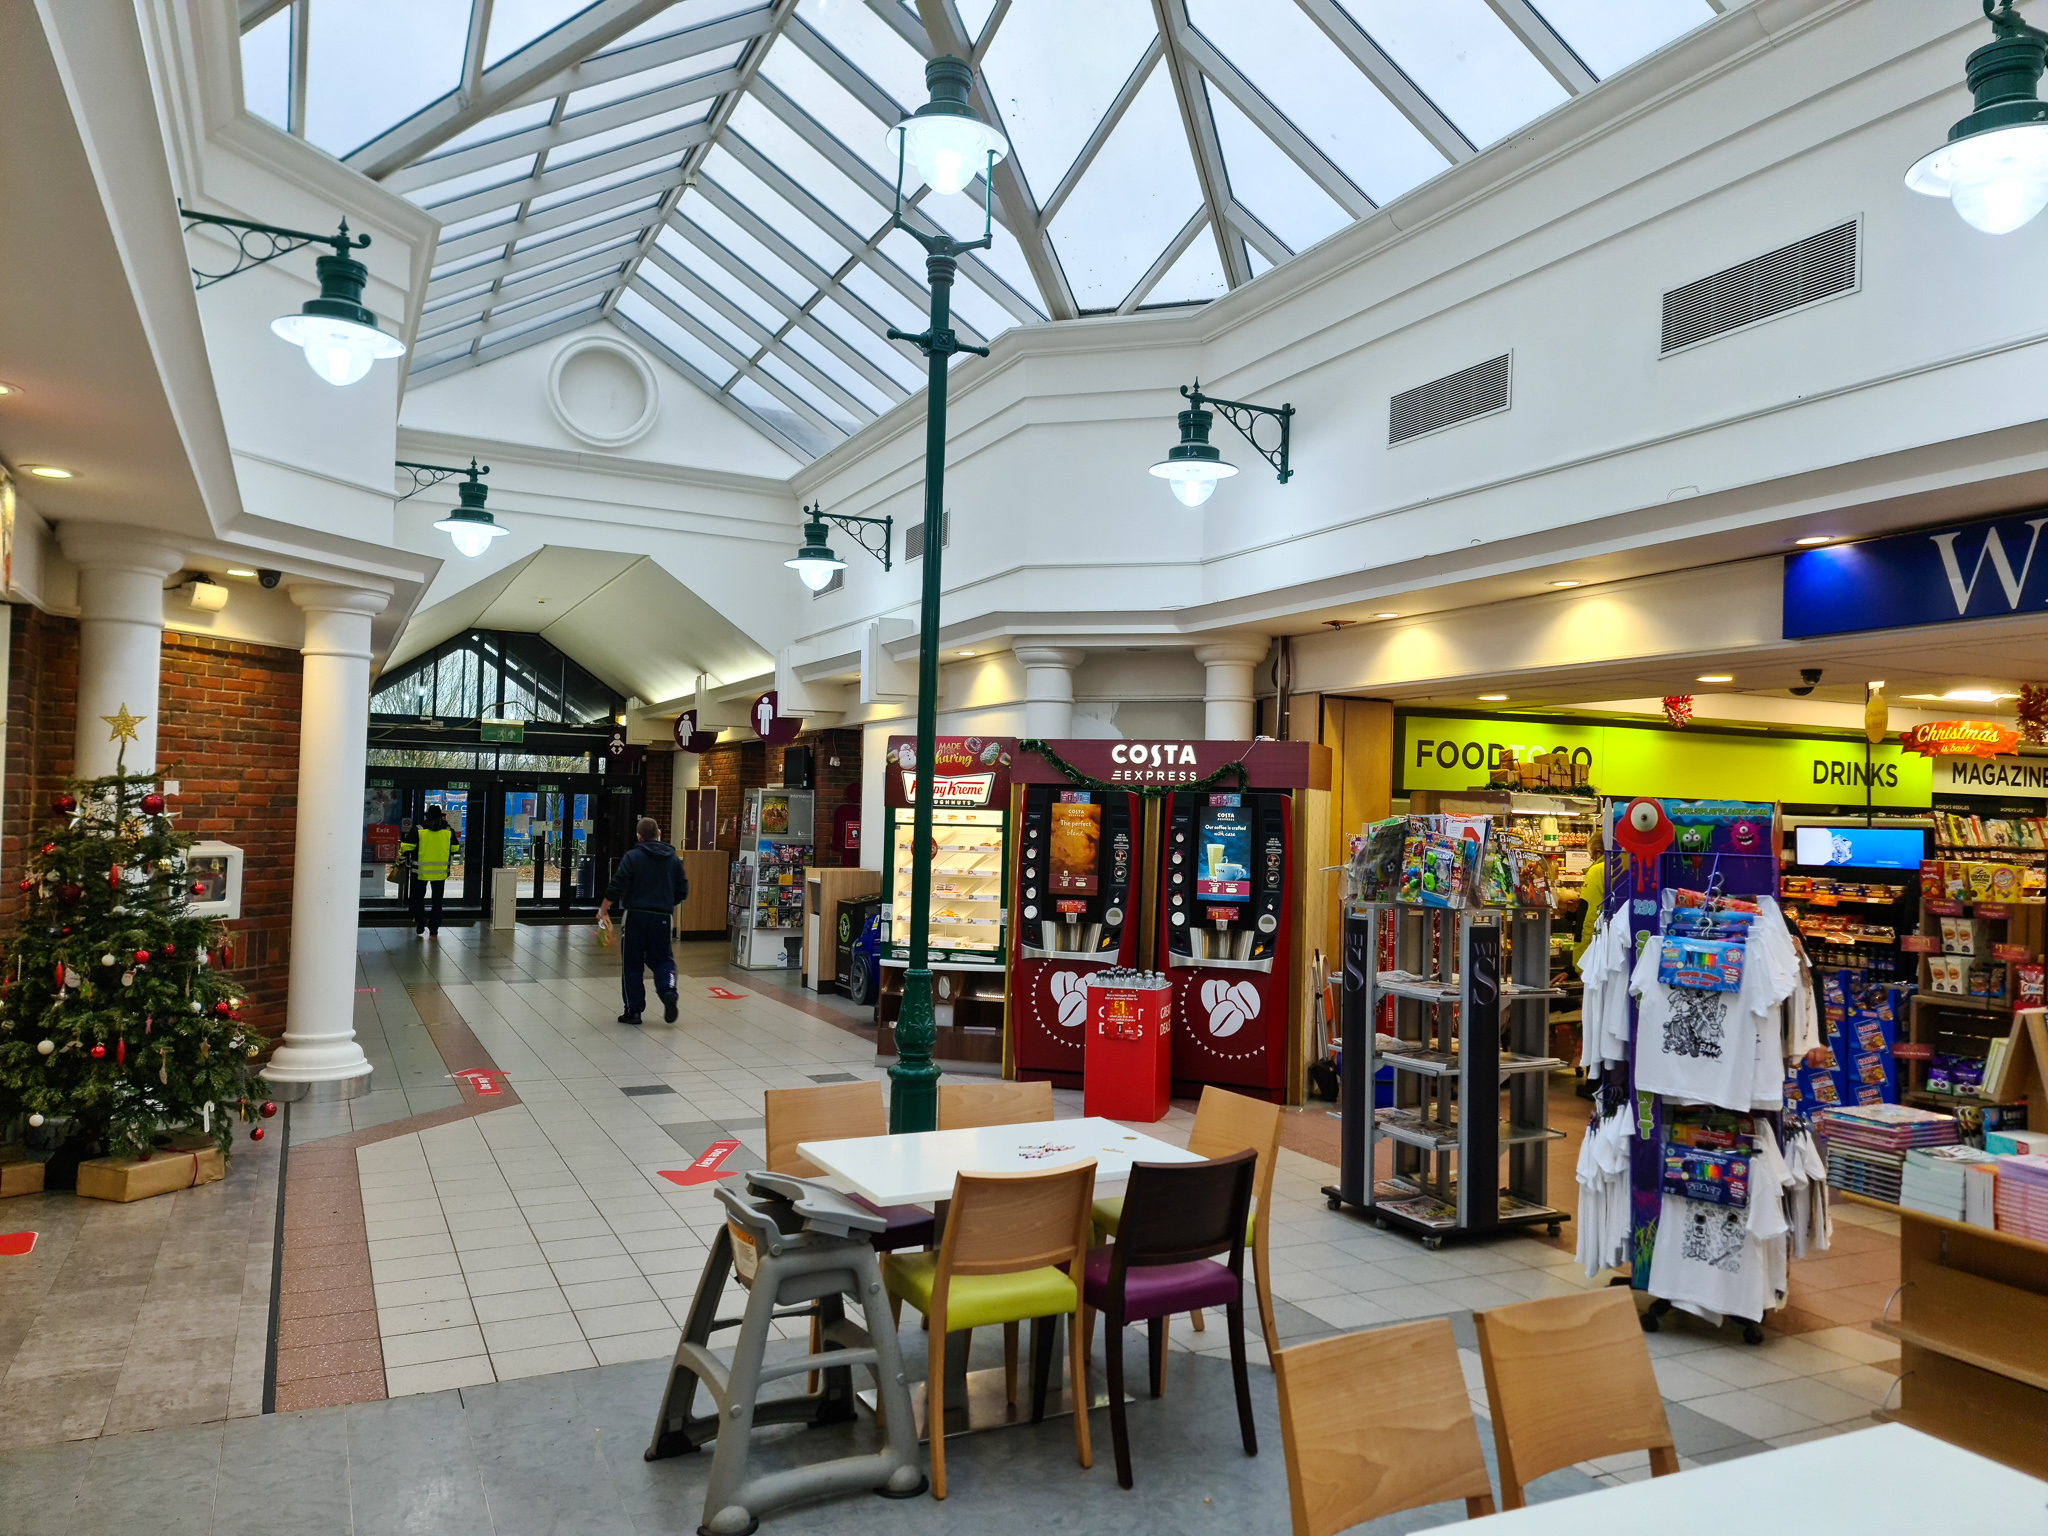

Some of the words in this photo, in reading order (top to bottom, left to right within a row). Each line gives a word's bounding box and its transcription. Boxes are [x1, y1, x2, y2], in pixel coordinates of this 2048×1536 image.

[1917, 724, 2000, 743] Christmas
[1416, 739, 1503, 770] FOOD
[1940, 744, 1949, 753] is
[1950, 743, 1976, 753] back!
[935, 750, 974, 767] haring
[1111, 744, 1197, 767] COSTA
[1123, 770, 1197, 782] EXPRESS
[1812, 760, 1898, 788] DRINKS
[1952, 762, 2048, 788] MAGAZINE
[947, 780, 985, 796] Kreme
[1072, 820, 1092, 828] perfect
[1474, 942, 1497, 956] WH
[1474, 956, 1498, 1006] S
[1114, 1000, 1125, 1014] £1
[1700, 1043, 1720, 1055] BAM
[708, 1148, 728, 1157] One
[696, 1158, 716, 1168] way
[1686, 1182, 1722, 1196] SPACE
